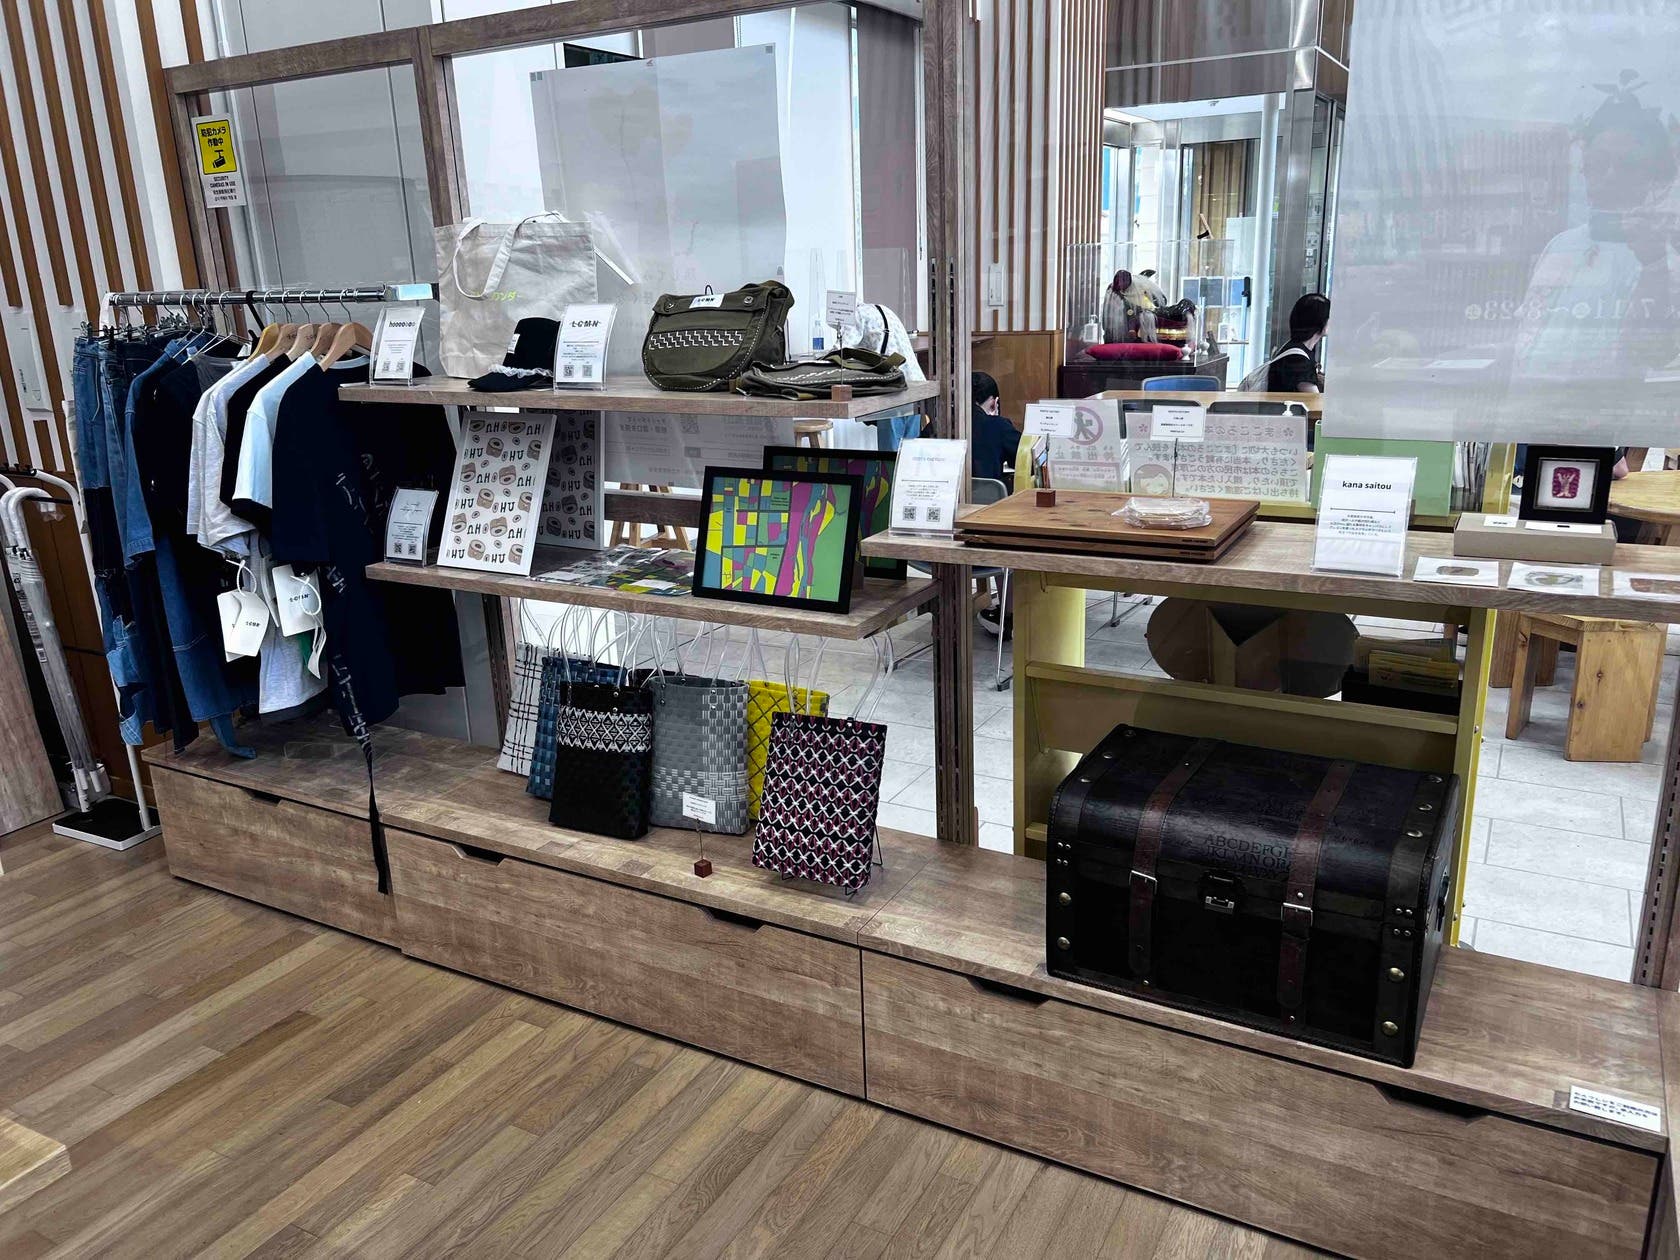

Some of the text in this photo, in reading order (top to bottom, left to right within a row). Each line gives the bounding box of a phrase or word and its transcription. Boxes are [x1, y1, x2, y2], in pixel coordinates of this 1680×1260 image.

[200, 126, 226, 137] 防犯カメラ
[1342, 480, 1392, 490] kana saitou
